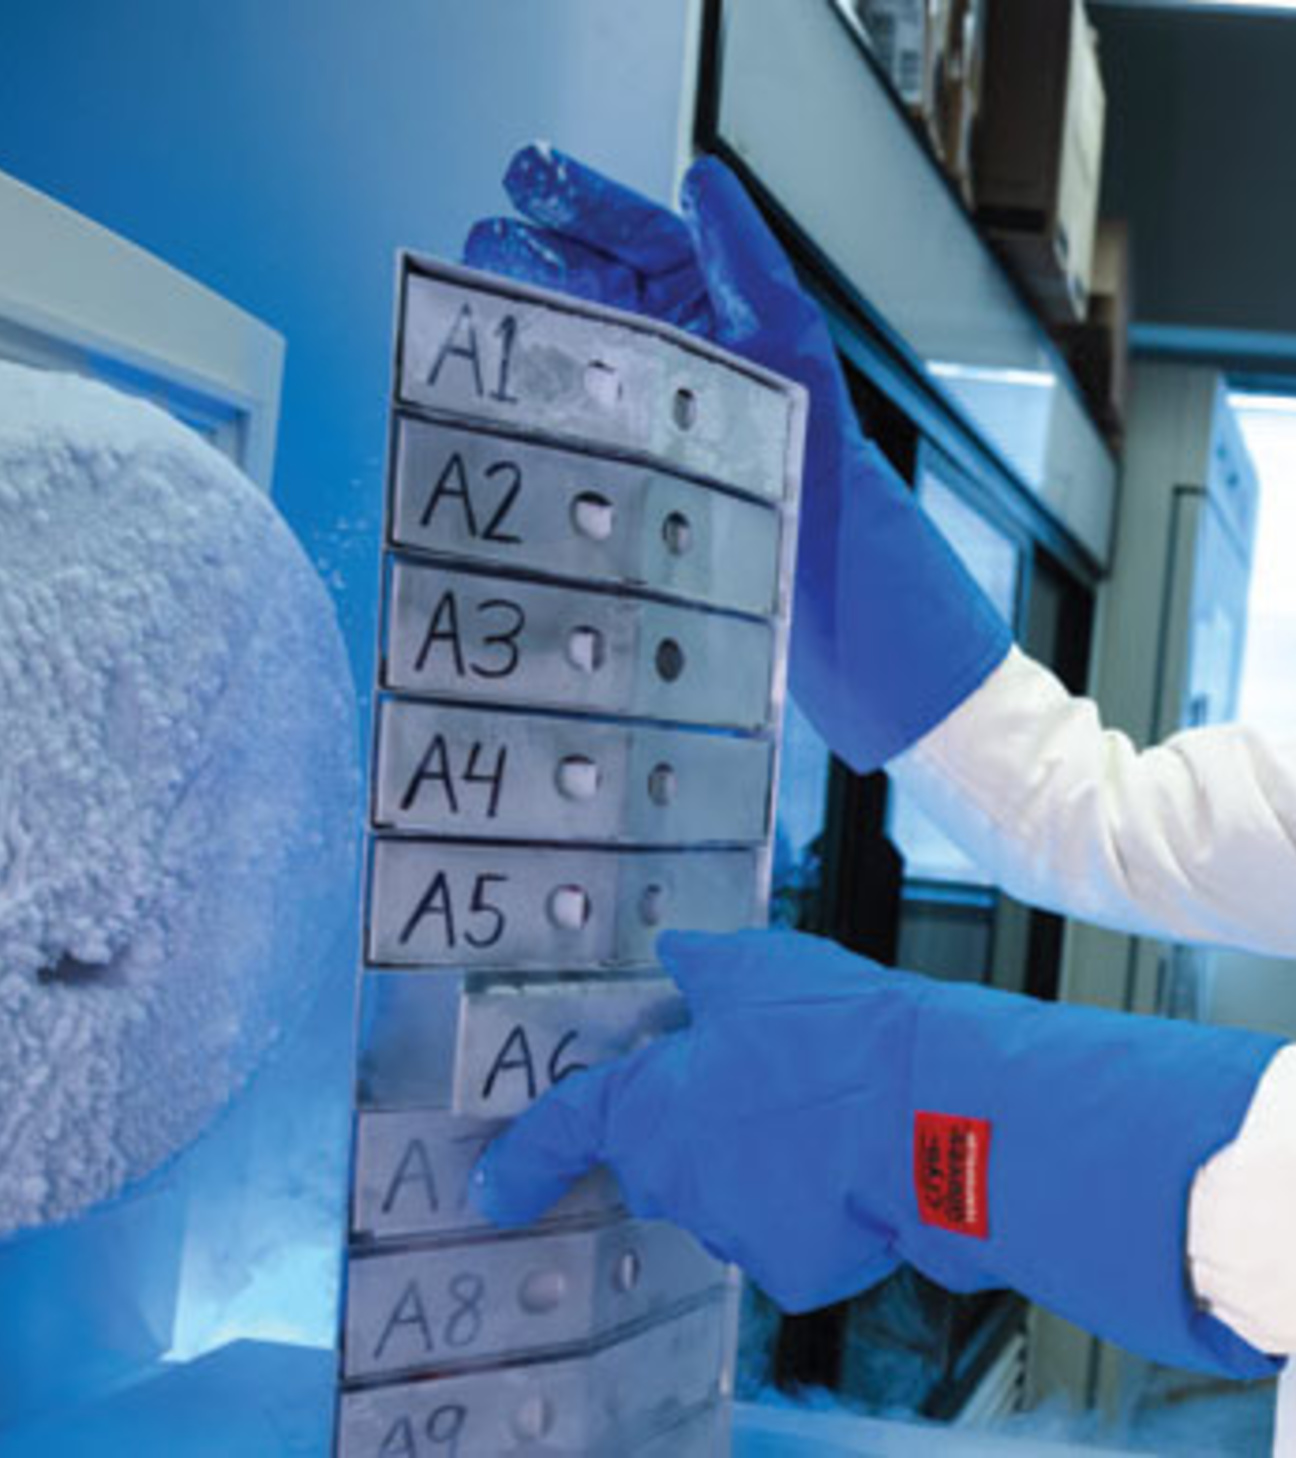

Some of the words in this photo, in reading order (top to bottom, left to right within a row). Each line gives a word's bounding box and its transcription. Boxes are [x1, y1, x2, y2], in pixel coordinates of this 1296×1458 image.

[427, 302, 519, 404] A1
[419, 452, 523, 544] A2
[414, 590, 526, 679] A3
[400, 734, 507, 819] A4
[398, 869, 510, 949] A5
[482, 1025, 589, 1100] A6
[373, 1271, 485, 1360] A8
[376, 1403, 468, 1458] A9
